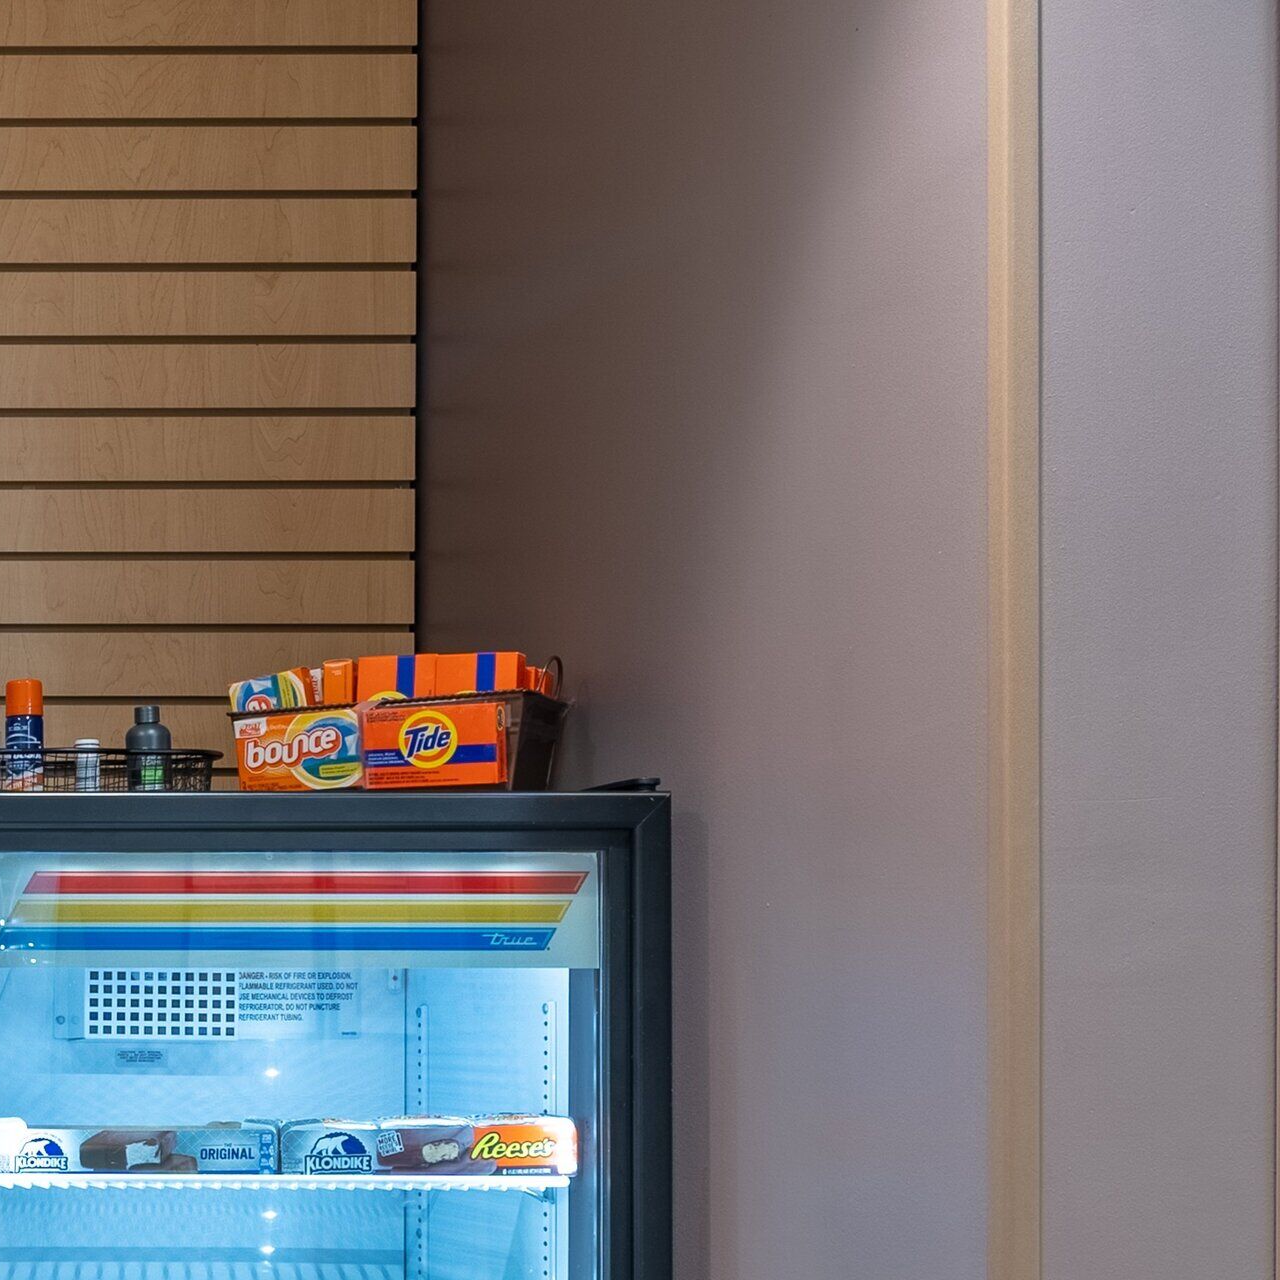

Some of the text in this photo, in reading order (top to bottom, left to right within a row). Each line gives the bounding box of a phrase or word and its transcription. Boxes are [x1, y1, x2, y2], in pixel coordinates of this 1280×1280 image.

[246, 727, 338, 769] bounce
[404, 725, 452, 761] Tide
[268, 972, 283, 980] RISK
[284, 972, 292, 980] OF
[293, 972, 307, 980] FIRE
[308, 972, 317, 980] OR
[275, 982, 316, 990] REFRIGERANT
[336, 982, 345, 990] DO
[346, 982, 358, 990] NOT
[251, 993, 289, 1001] MECHANICAL
[290, 993, 316, 1001] DEVICES
[316, 993, 325, 1001] TO
[325, 993, 353, 1001] DEFROST
[285, 1003, 295, 1011] DO
[295, 1003, 308, 1011] NOT
[308, 1003, 341, 1011] PUNCTURE
[471, 1131, 557, 1161] Reese's
[200, 1147, 255, 1161] ORIGINAL
[14, 1155, 68, 1172] KLONDIKE
[305, 1155, 372, 1173] KLONDIKE
